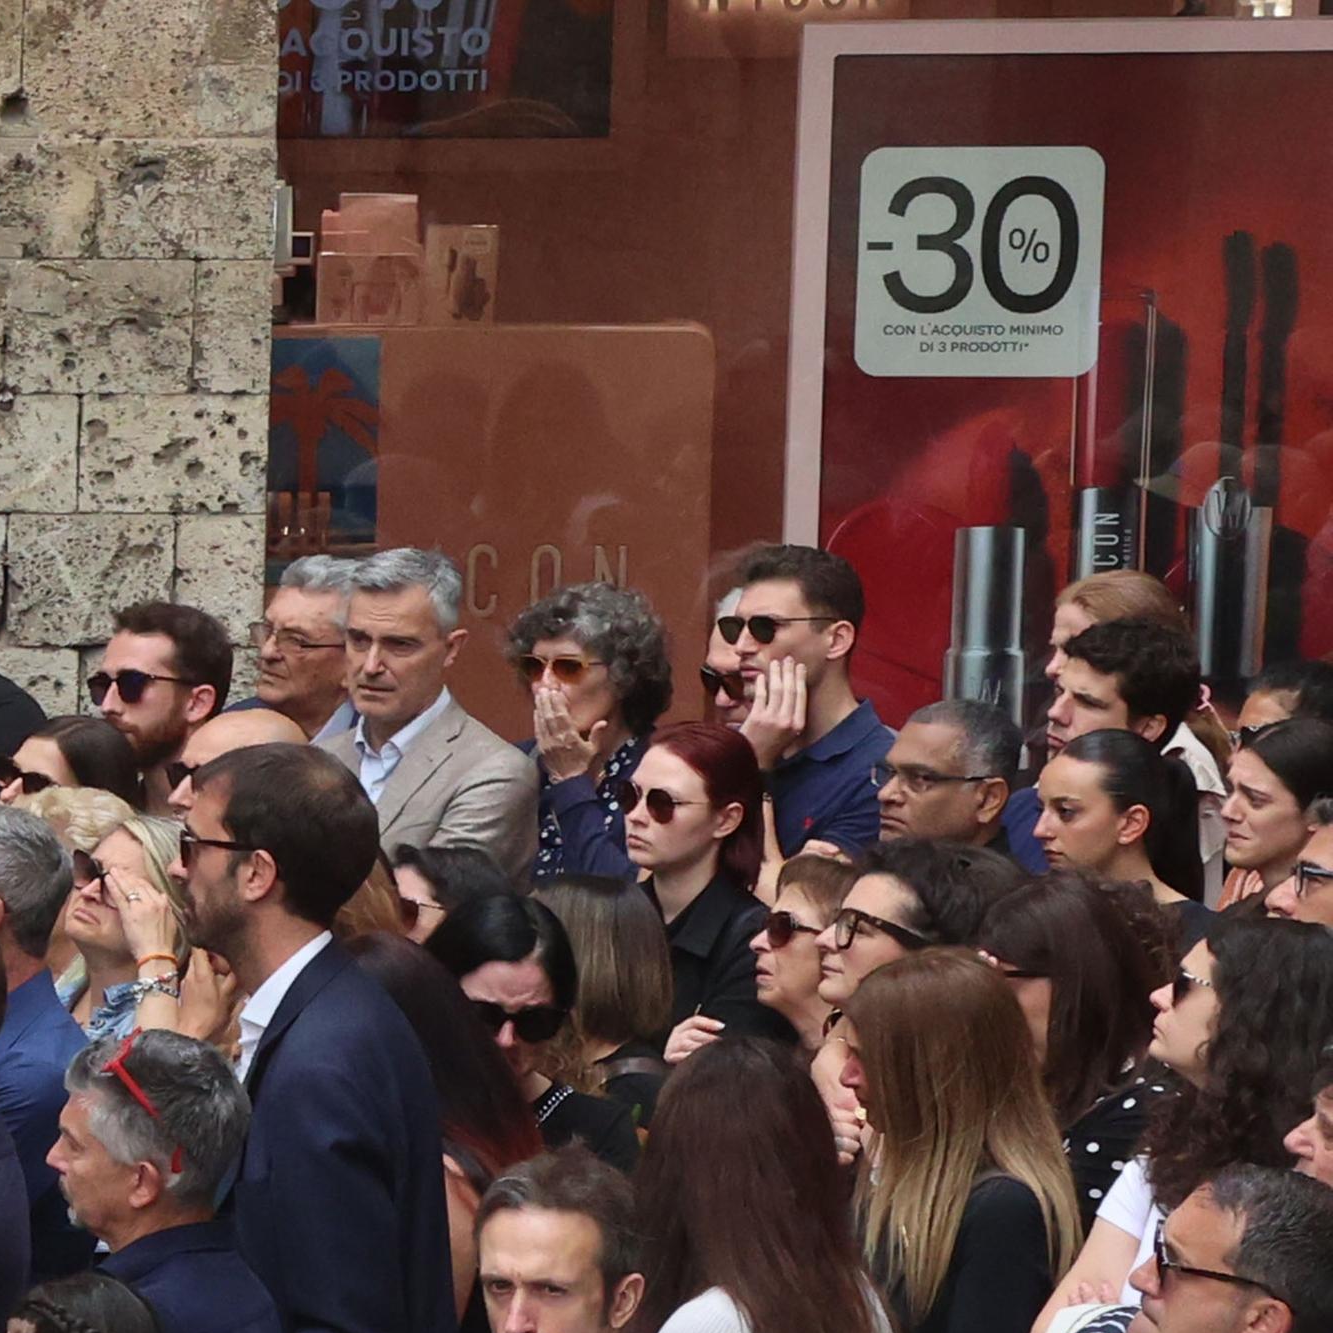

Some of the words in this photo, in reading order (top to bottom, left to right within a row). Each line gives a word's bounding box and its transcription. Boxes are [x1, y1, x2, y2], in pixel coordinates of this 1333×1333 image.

[280, 27, 491, 60] ACQUISTO
[337, 70, 487, 92] PRODOTTI
[883, 325, 916, 336] CON
[920, 323, 1006, 337] L'ACQUISTO
[1009, 325, 1064, 336] MINIMO
[920, 341, 934, 352] DI
[938, 341, 947, 352] 3
